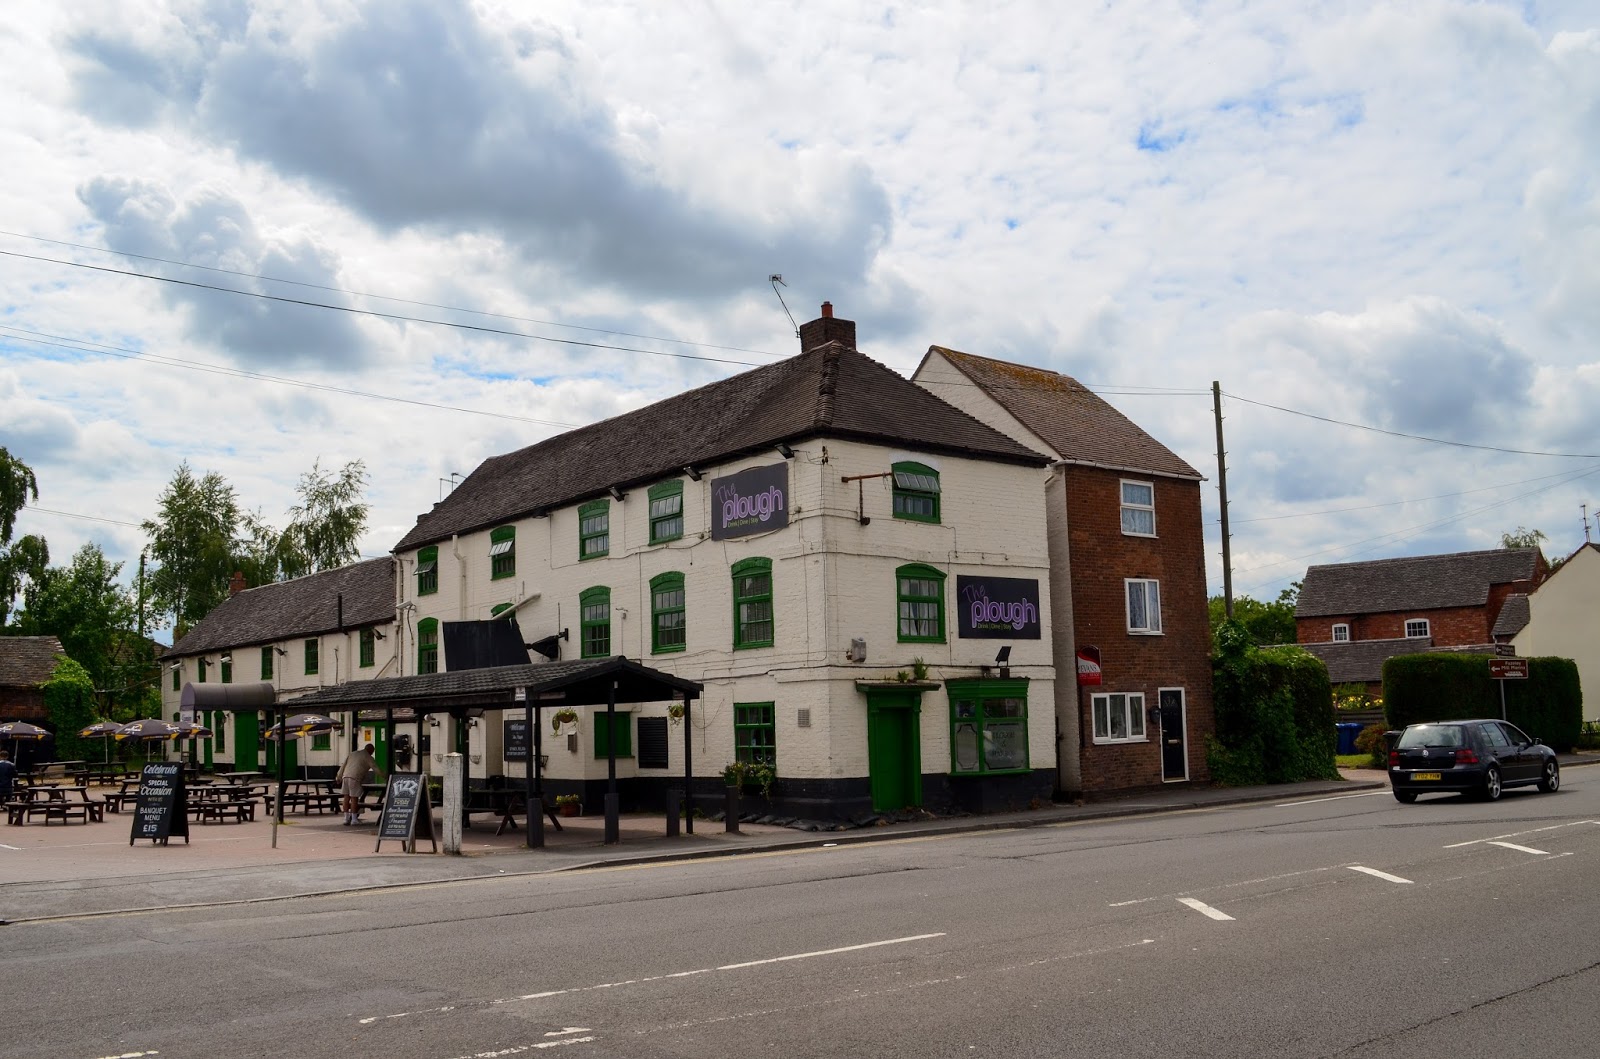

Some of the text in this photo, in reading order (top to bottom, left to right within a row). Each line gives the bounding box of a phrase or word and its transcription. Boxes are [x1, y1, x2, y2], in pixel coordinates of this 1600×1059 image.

[715, 483, 736, 504] The
[722, 485, 783, 528] plough
[962, 584, 986, 602] The
[971, 596, 1037, 630] plough
[144, 764, 178, 774] Celebrate
[140, 786, 172, 796] Occasion
[142, 824, 158, 832] £15
